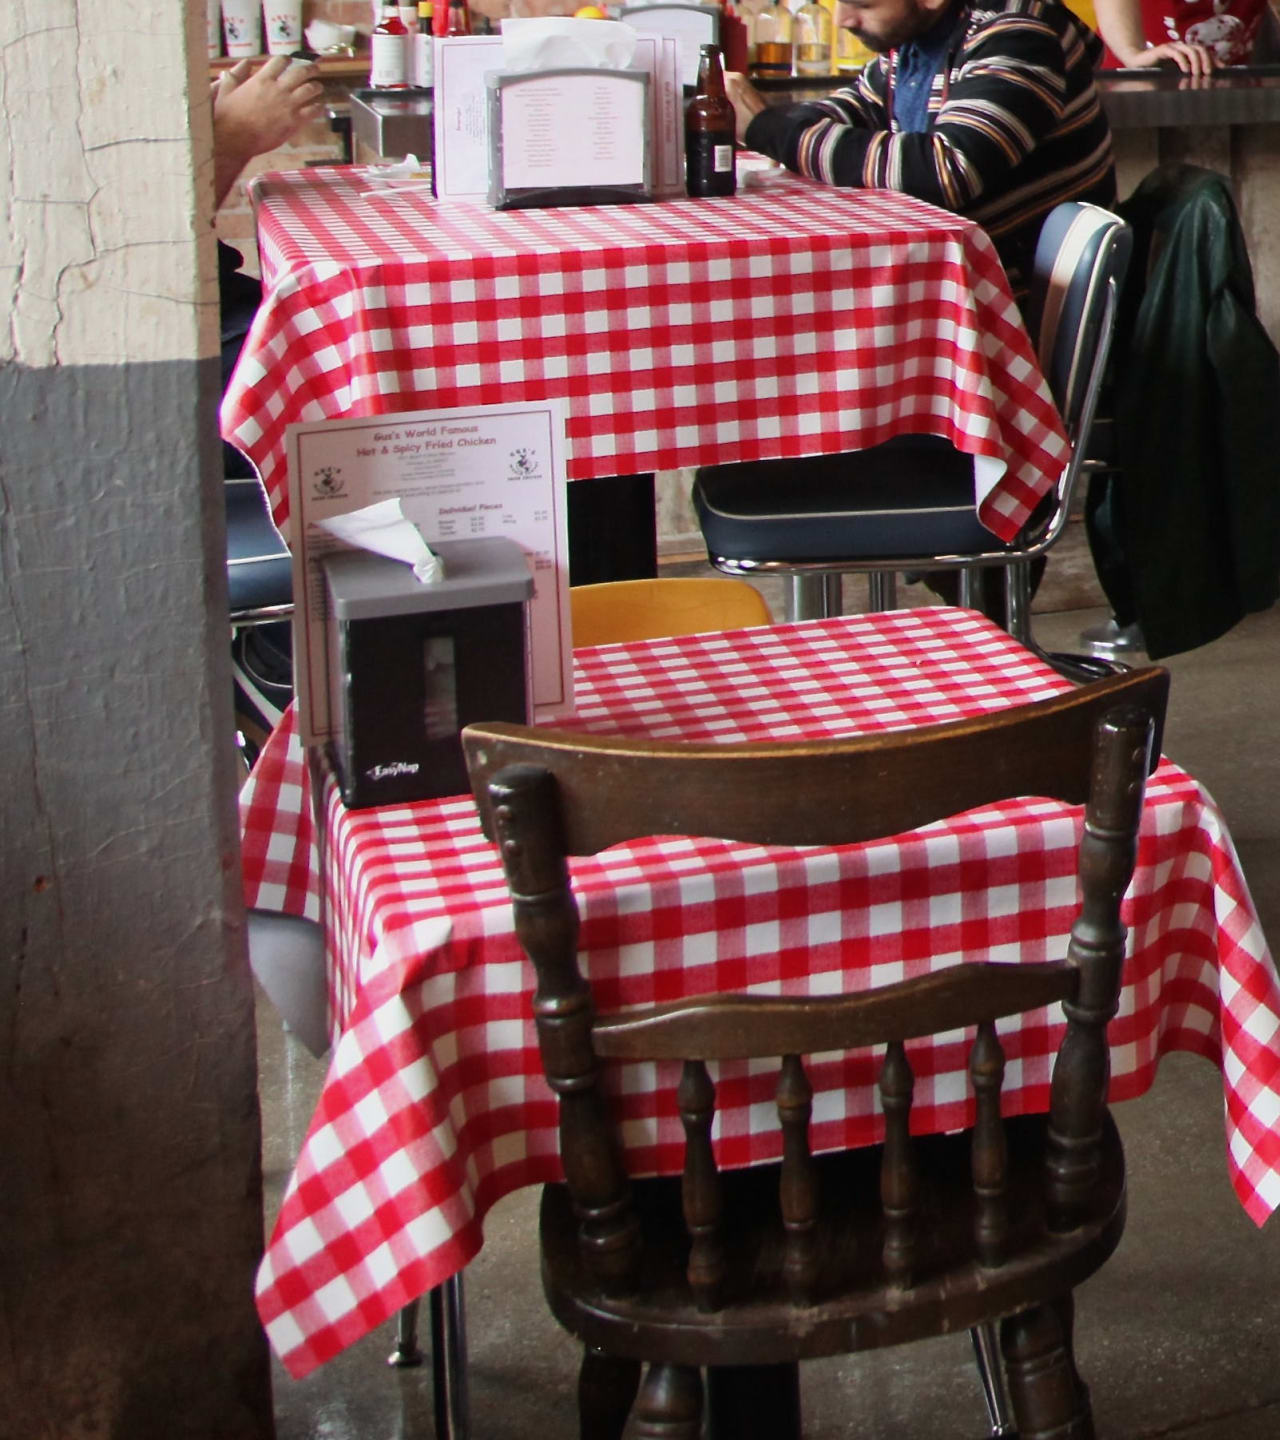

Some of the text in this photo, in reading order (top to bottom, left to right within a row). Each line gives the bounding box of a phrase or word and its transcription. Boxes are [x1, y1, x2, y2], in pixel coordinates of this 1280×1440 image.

[405, 427, 437, 439] World
[440, 424, 479, 435] Famous
[356, 447, 376, 458] Hot
[393, 443, 422, 456] Spicy
[425, 439, 453, 451] Fried
[457, 436, 497, 448] Chicken
